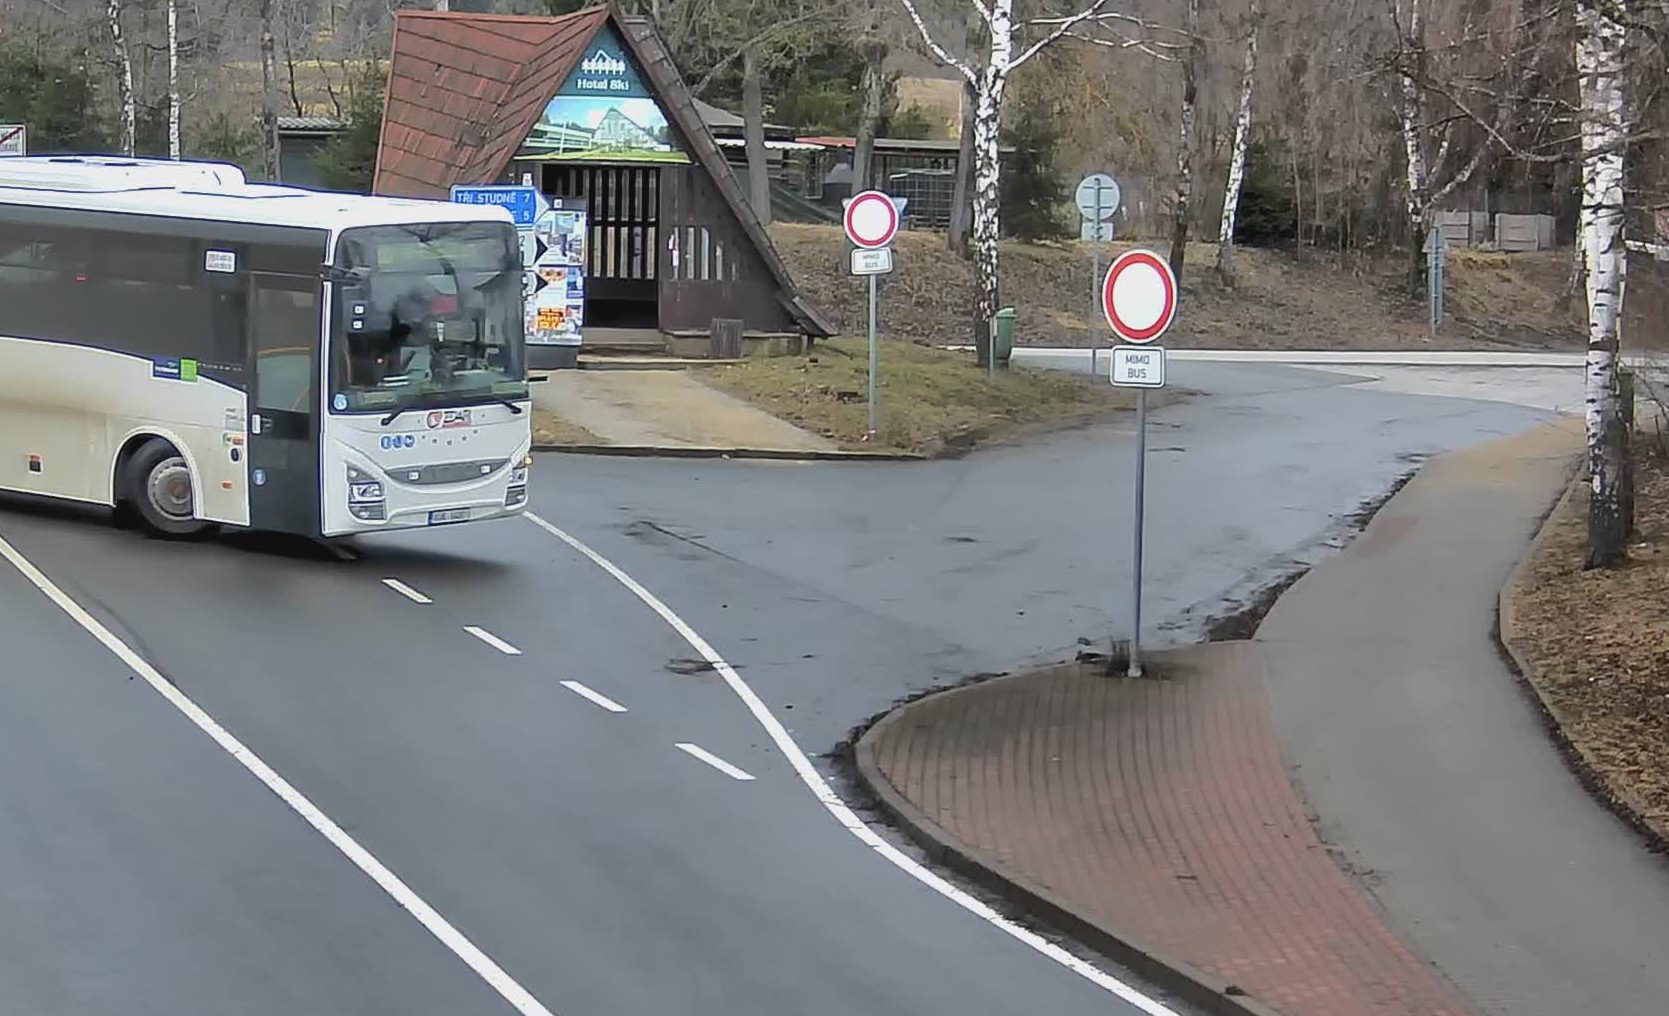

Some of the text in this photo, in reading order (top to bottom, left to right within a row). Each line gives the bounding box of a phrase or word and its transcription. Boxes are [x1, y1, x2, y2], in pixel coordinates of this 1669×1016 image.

[577, 79, 629, 90] Hotel Ski
[457, 192, 473, 203] TŘI
[524, 193, 531, 203] 7
[523, 210, 530, 220] 5
[1125, 354, 1150, 365] MIMO
[1127, 367, 1147, 379] BUS
